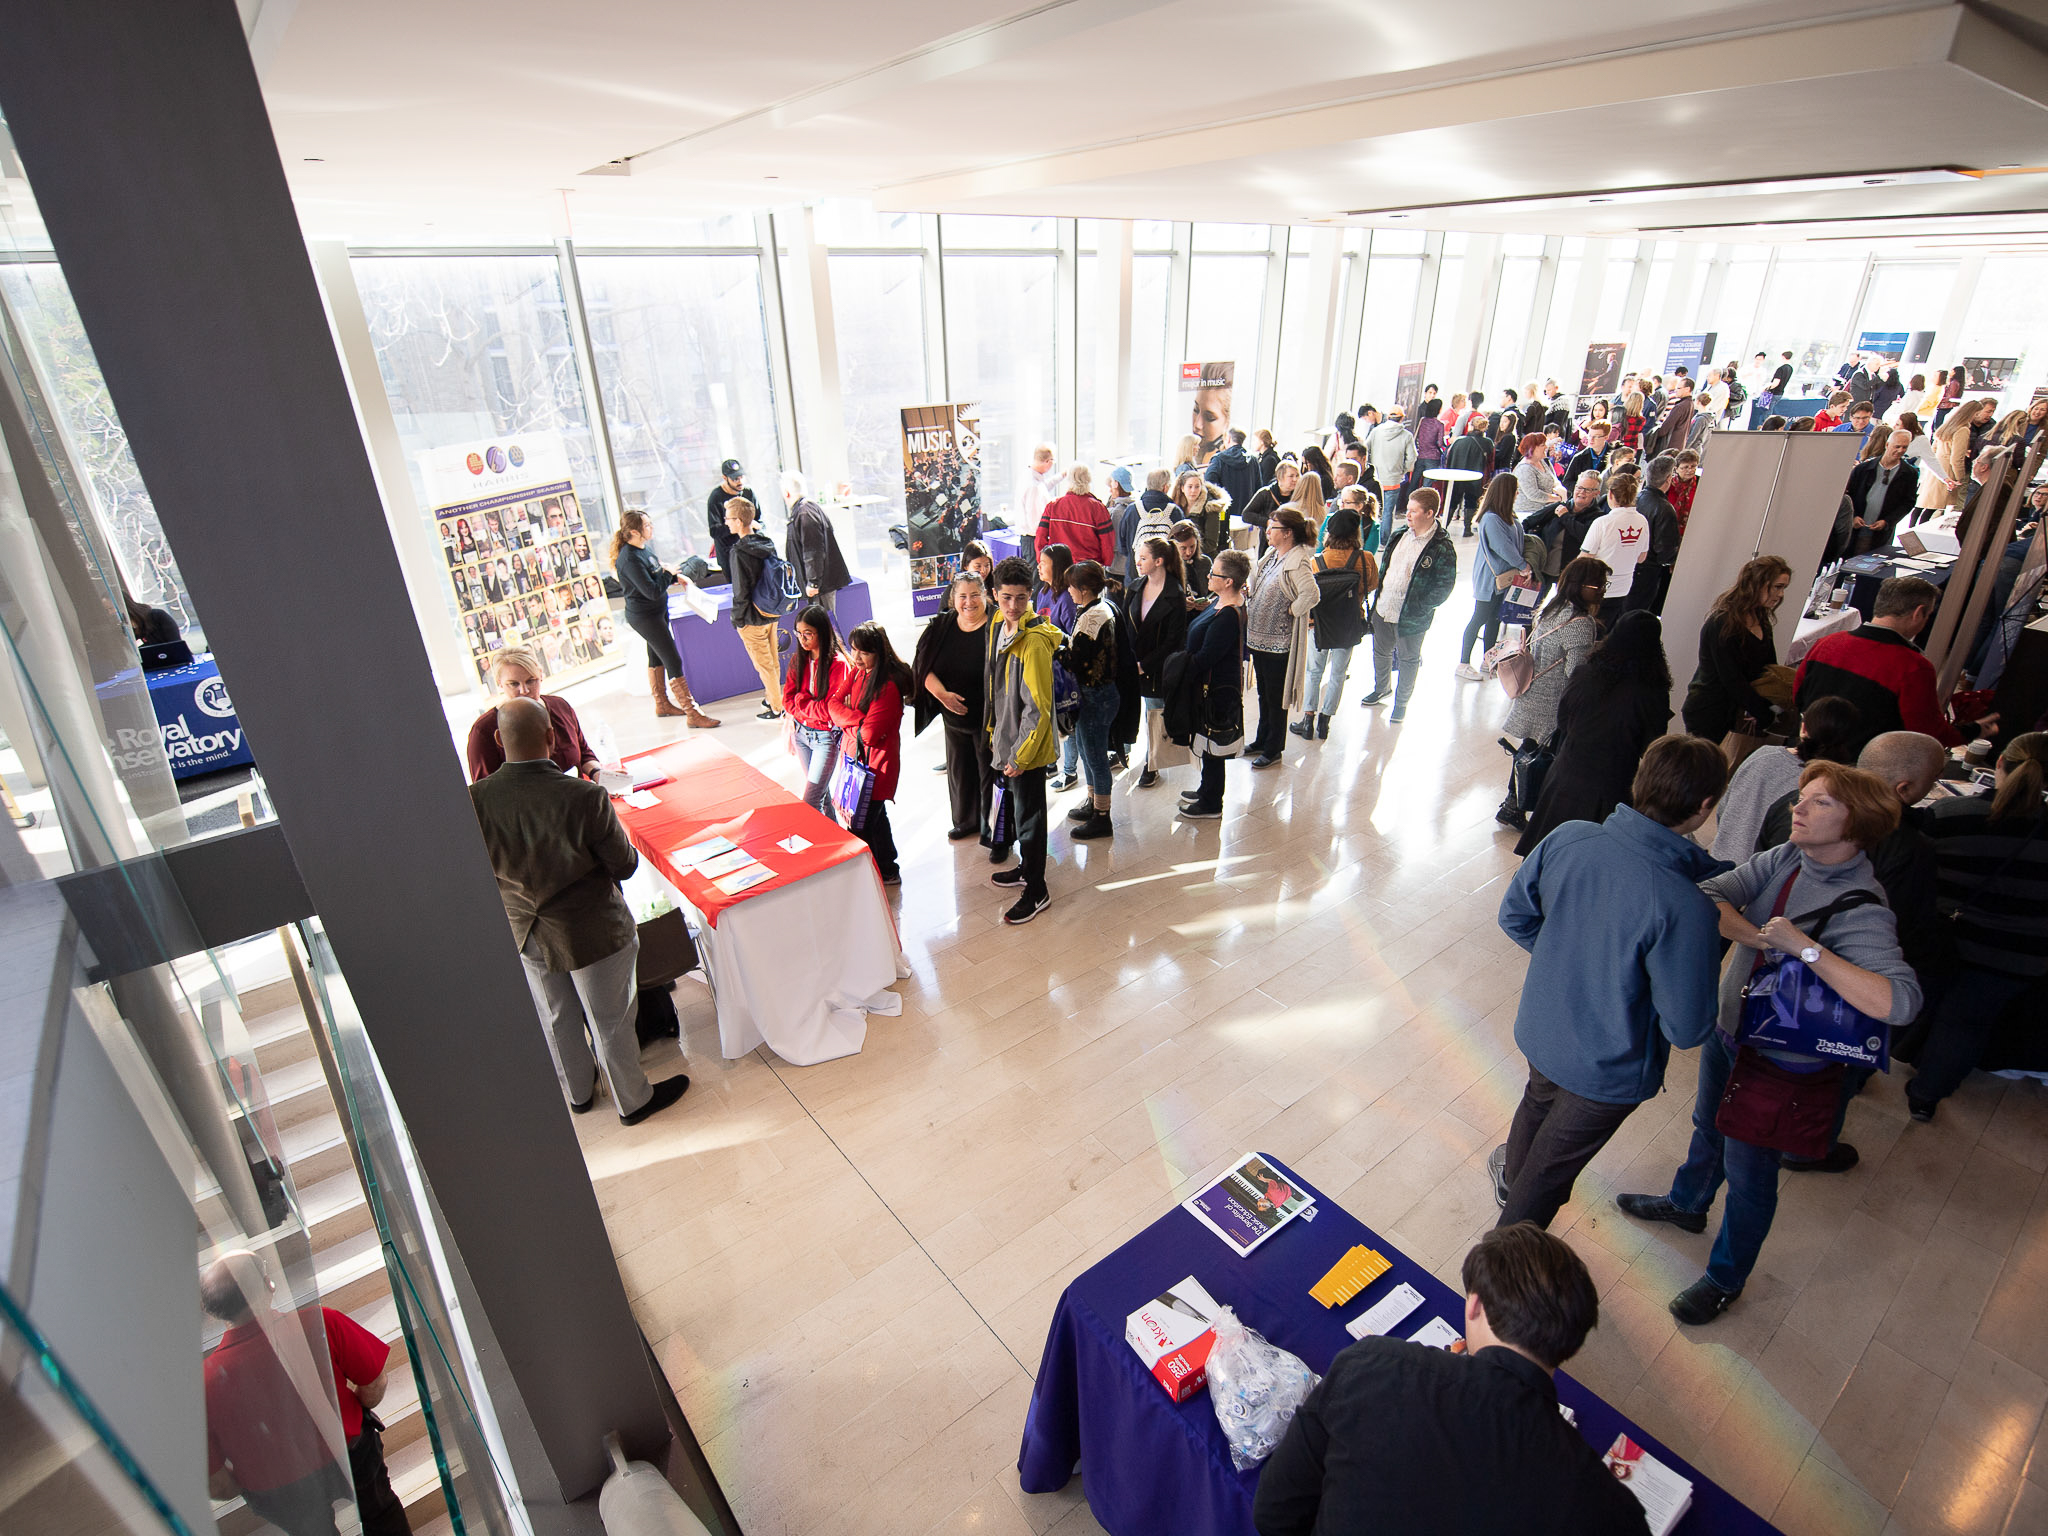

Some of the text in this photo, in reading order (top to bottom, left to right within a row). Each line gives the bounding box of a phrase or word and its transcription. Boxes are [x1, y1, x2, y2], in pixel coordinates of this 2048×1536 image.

[1201, 378, 1207, 387] in
[1207, 377, 1226, 387] music
[907, 431, 952, 453] MUSIC
[439, 483, 568, 516] ANOTHER CHAMPIONSHIP SEASON!
[916, 593, 942, 603] Western
[187, 758, 204, 767] the
[1816, 1045, 1878, 1064] Conservatory
[1817, 1038, 1864, 1054] The Royal
[1224, 1203, 1233, 1211] of
[1227, 1196, 1253, 1219] Education
[1232, 1208, 1253, 1228] Benefits
[1251, 1217, 1268, 1232] Music
[1252, 1225, 1263, 1236] The
[1141, 1312, 1175, 1348] Akron
[1167, 1361, 1183, 1379] 250
